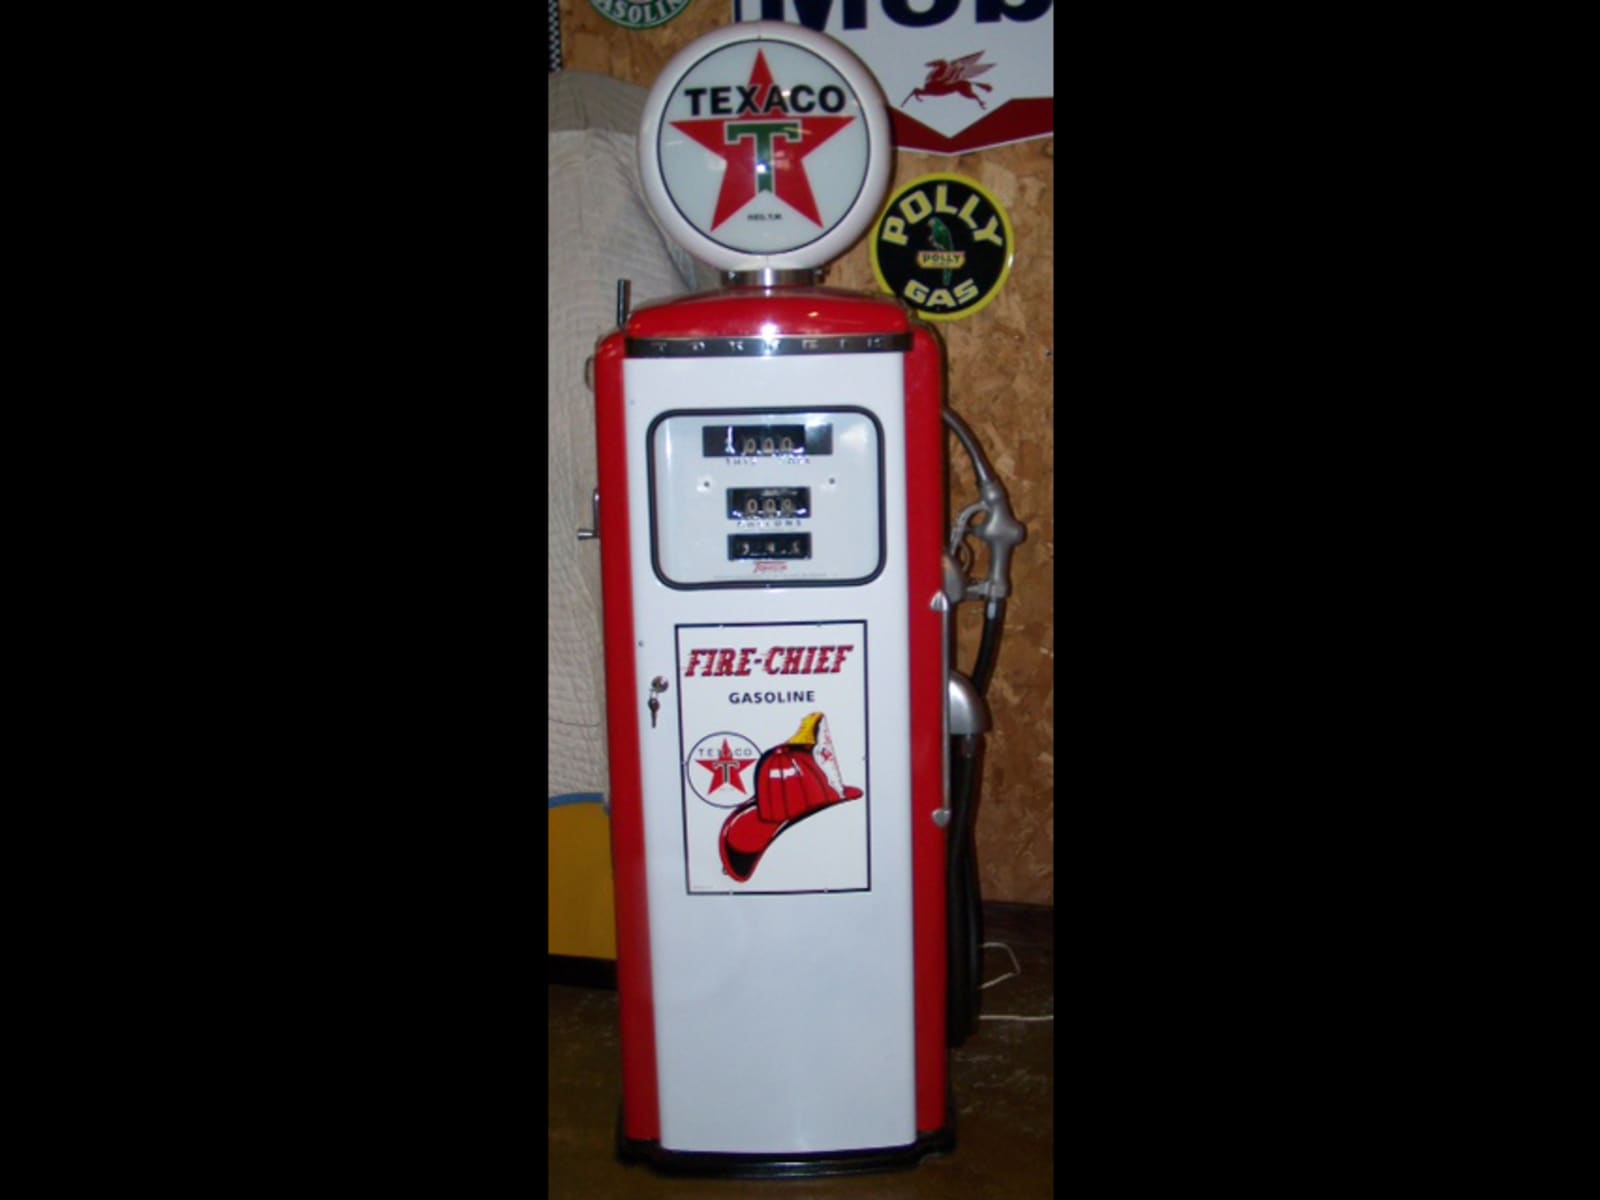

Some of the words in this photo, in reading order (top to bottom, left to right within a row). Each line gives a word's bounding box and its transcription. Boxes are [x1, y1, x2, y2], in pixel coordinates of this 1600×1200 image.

[684, 85, 846, 116] TEXACO
[882, 185, 1003, 247] POLLY
[904, 280, 979, 307] GAS
[685, 644, 853, 677] FIRE-CHIEF
[728, 690, 816, 704] GASOLINE
